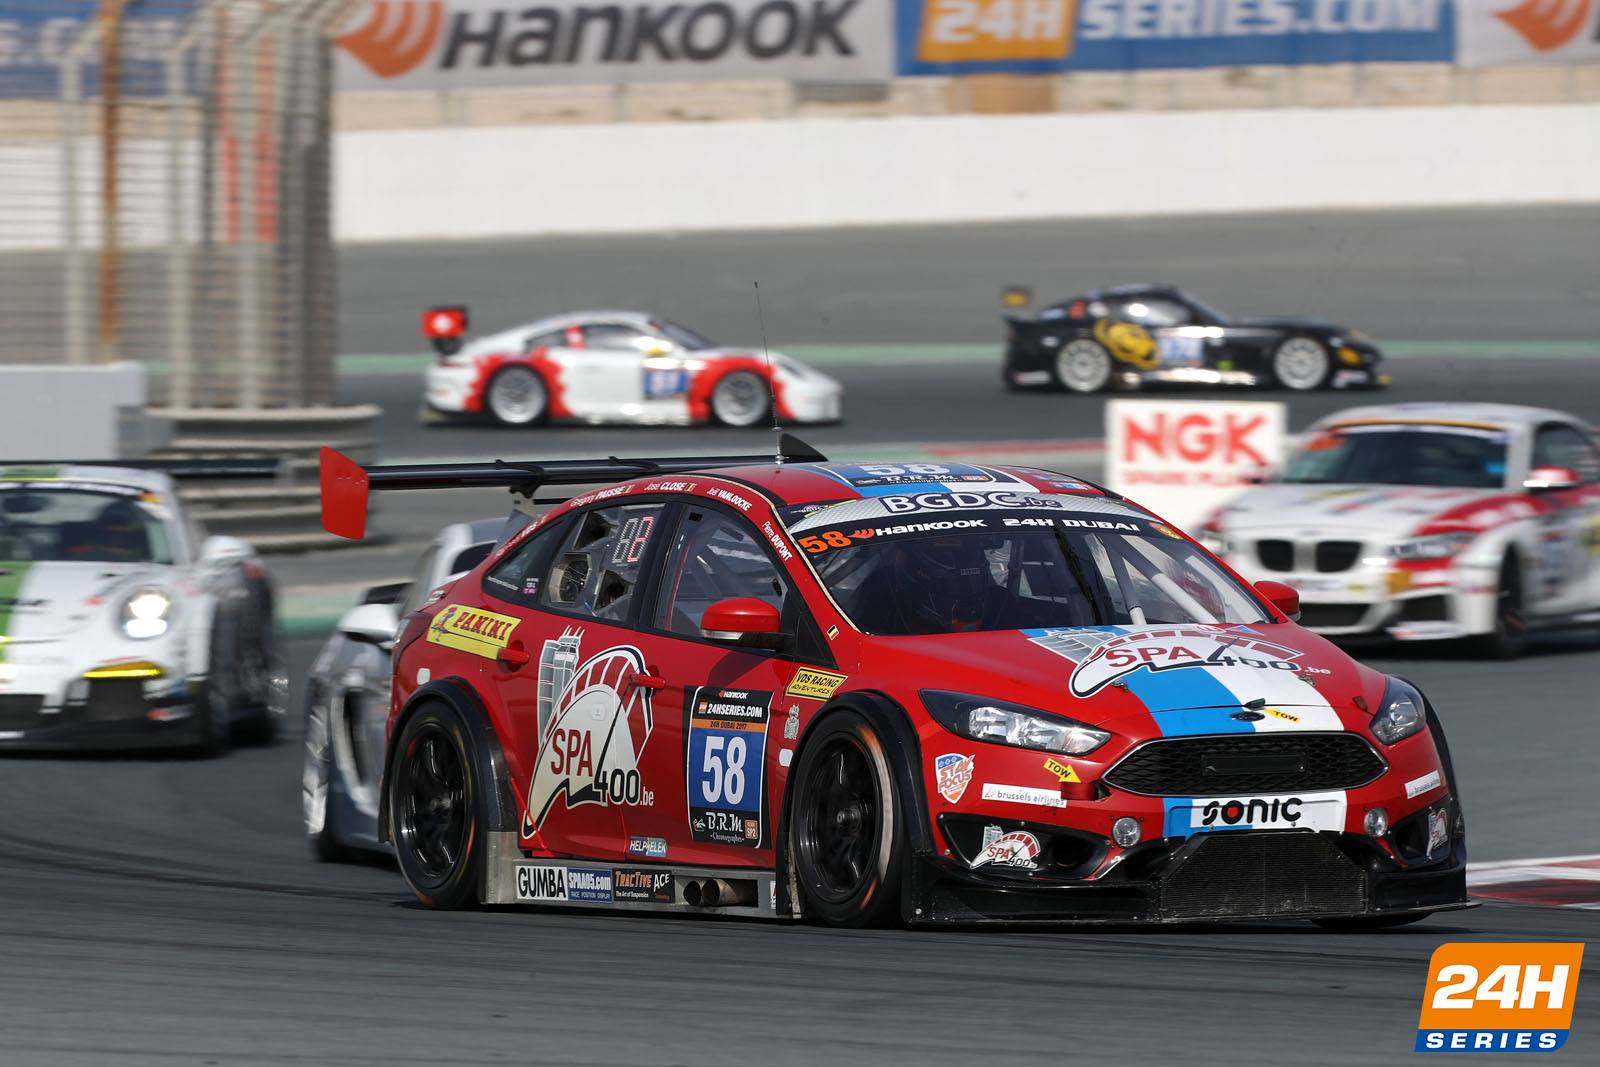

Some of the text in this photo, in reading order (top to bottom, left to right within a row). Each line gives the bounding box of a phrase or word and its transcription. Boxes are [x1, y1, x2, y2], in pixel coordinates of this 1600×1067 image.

[930, 0, 1438, 43] 24H SERIES.COM
[1121, 411, 1268, 465] NGK
[859, 463, 951, 476] 58
[660, 481, 687, 491] CLOSE
[717, 488, 753, 512] VANLOOCKE
[883, 492, 1062, 514] BGDC.be
[762, 521, 793, 561] Pierre DUPONT
[799, 531, 852, 554] 58
[1002, 518, 1055, 527] 24H
[1062, 519, 1141, 532] DUBAI
[453, 611, 513, 641] PANINI
[1105, 645, 1203, 668] SPA
[796, 672, 840, 689] VDS RACING
[706, 702, 763, 719] 24HSERIES.COM
[1275, 710, 1299, 723] TOW
[550, 728, 594, 778] SPA
[702, 735, 747, 805] 58
[1048, 760, 1071, 778] TOW
[996, 790, 1032, 802] brussels
[987, 846, 1010, 860] SPA
[518, 867, 567, 898] GUMBA
[653, 873, 670, 892] ACE
